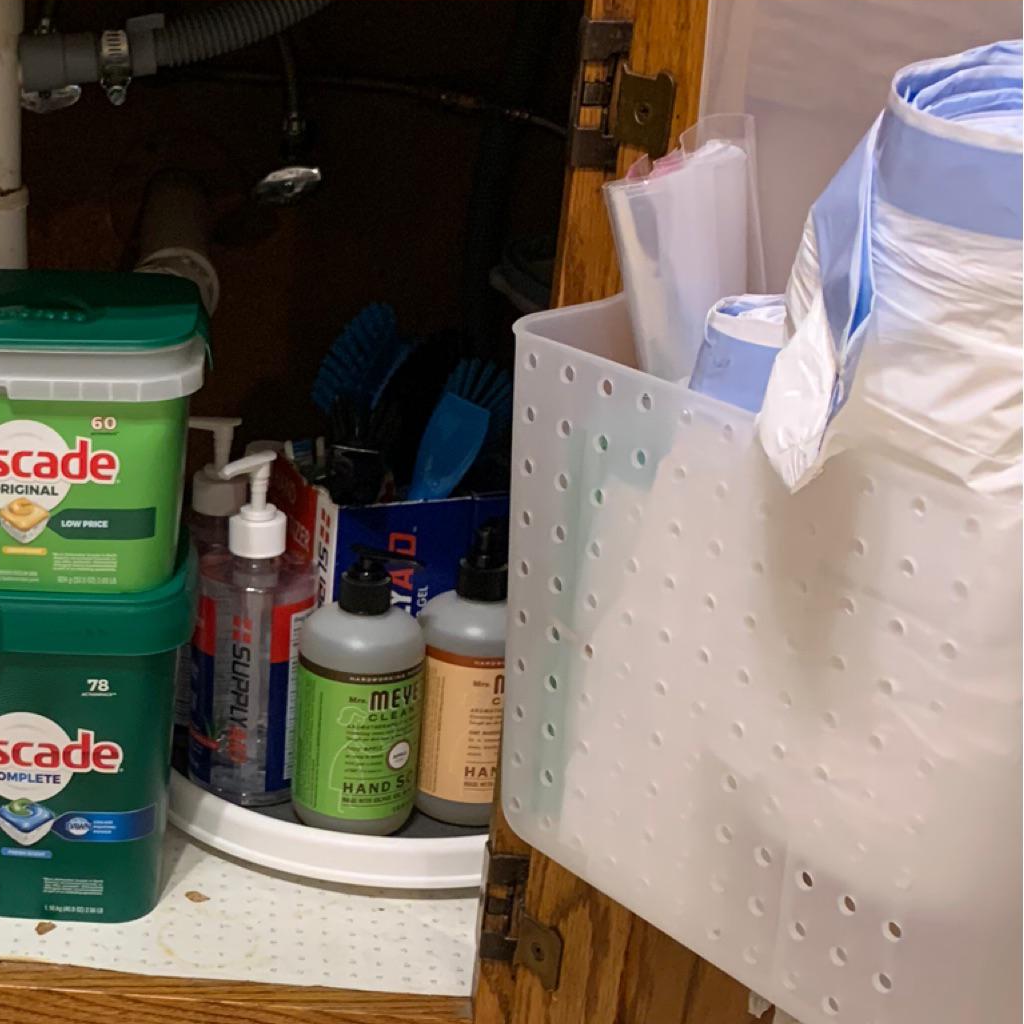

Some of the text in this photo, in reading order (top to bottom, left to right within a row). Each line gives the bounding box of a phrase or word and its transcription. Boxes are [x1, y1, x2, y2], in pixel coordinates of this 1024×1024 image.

[91, 416, 117, 430] 60
[60, 519, 109, 528] LOW PRICE
[87, 679, 109, 692] 78
[369, 681, 419, 712] MEYE
[492, 696, 502, 706] C
[343, 781, 391, 794] HAND
